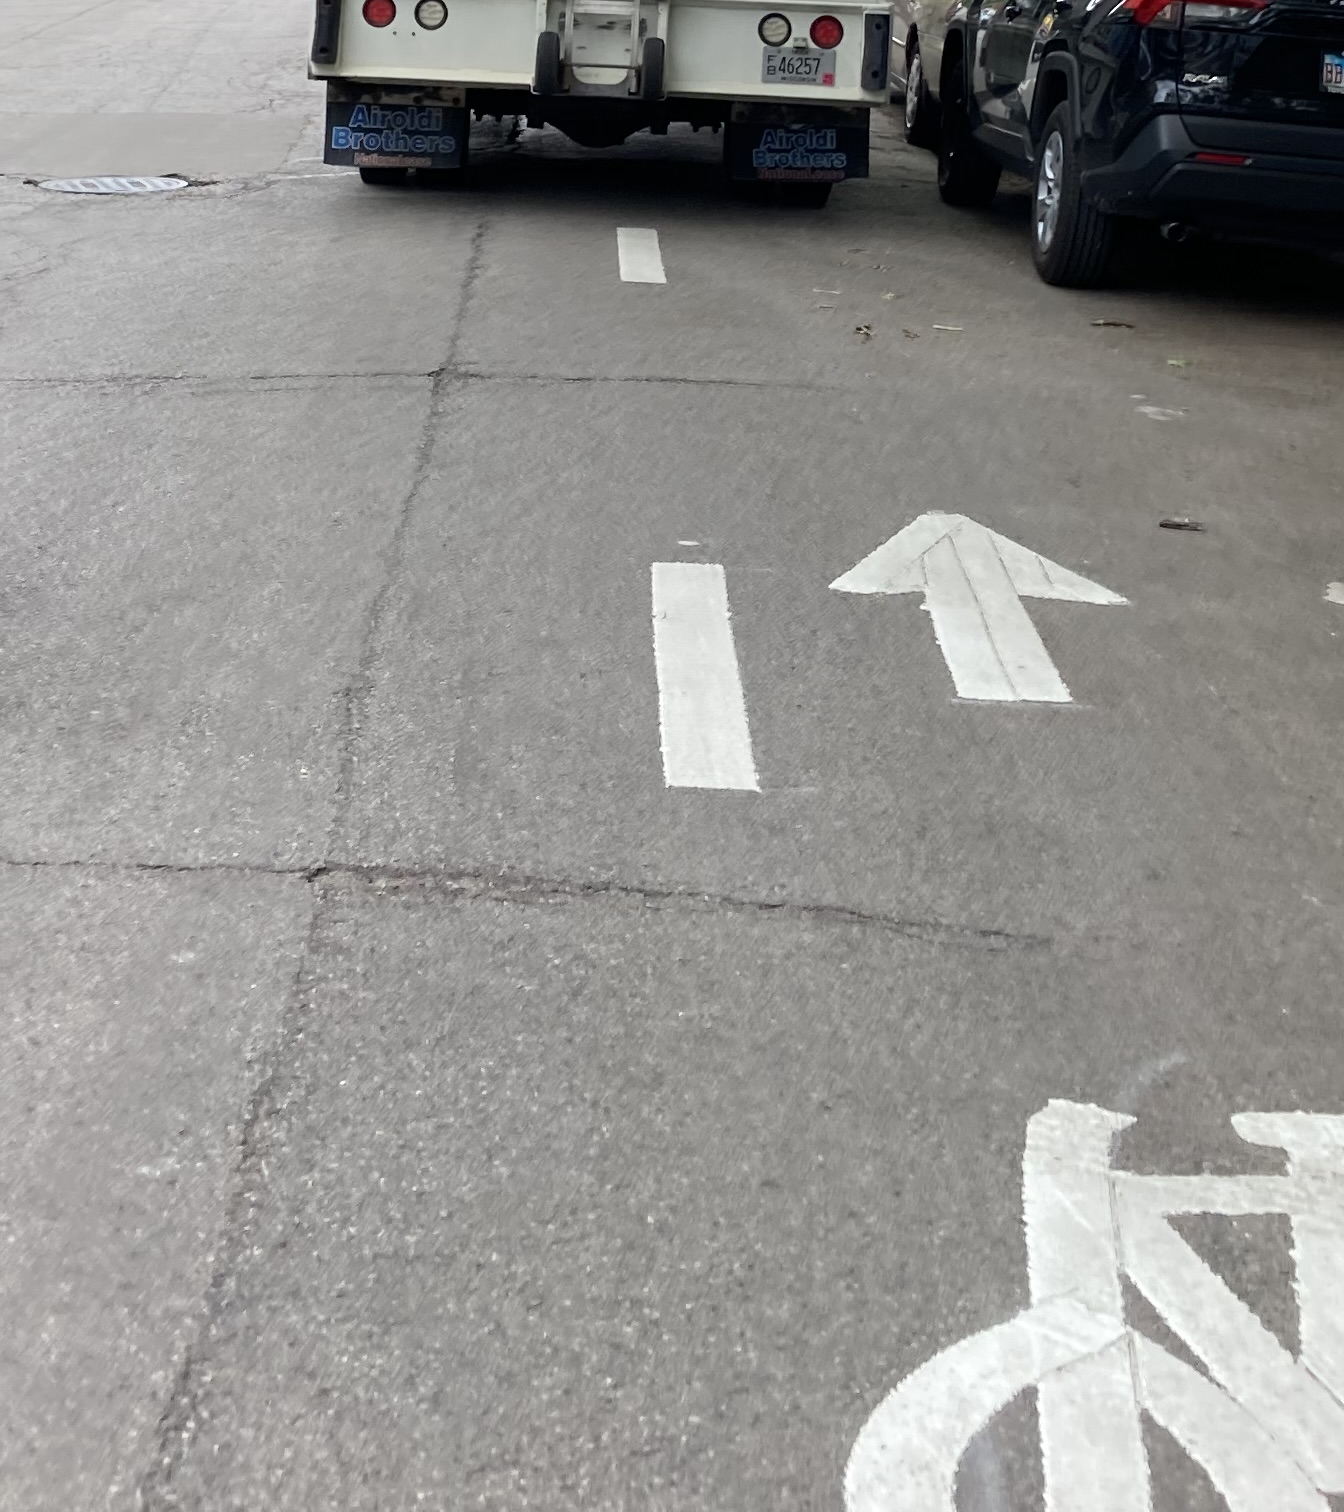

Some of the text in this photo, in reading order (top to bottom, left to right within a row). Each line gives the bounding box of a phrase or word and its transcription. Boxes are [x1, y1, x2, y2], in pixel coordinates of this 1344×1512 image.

[778, 56, 821, 76] 46257
[348, 104, 444, 131] Airoldi
[331, 126, 456, 154] Brothers
[759, 128, 837, 149] Airoldi
[752, 148, 847, 168] Brothers
